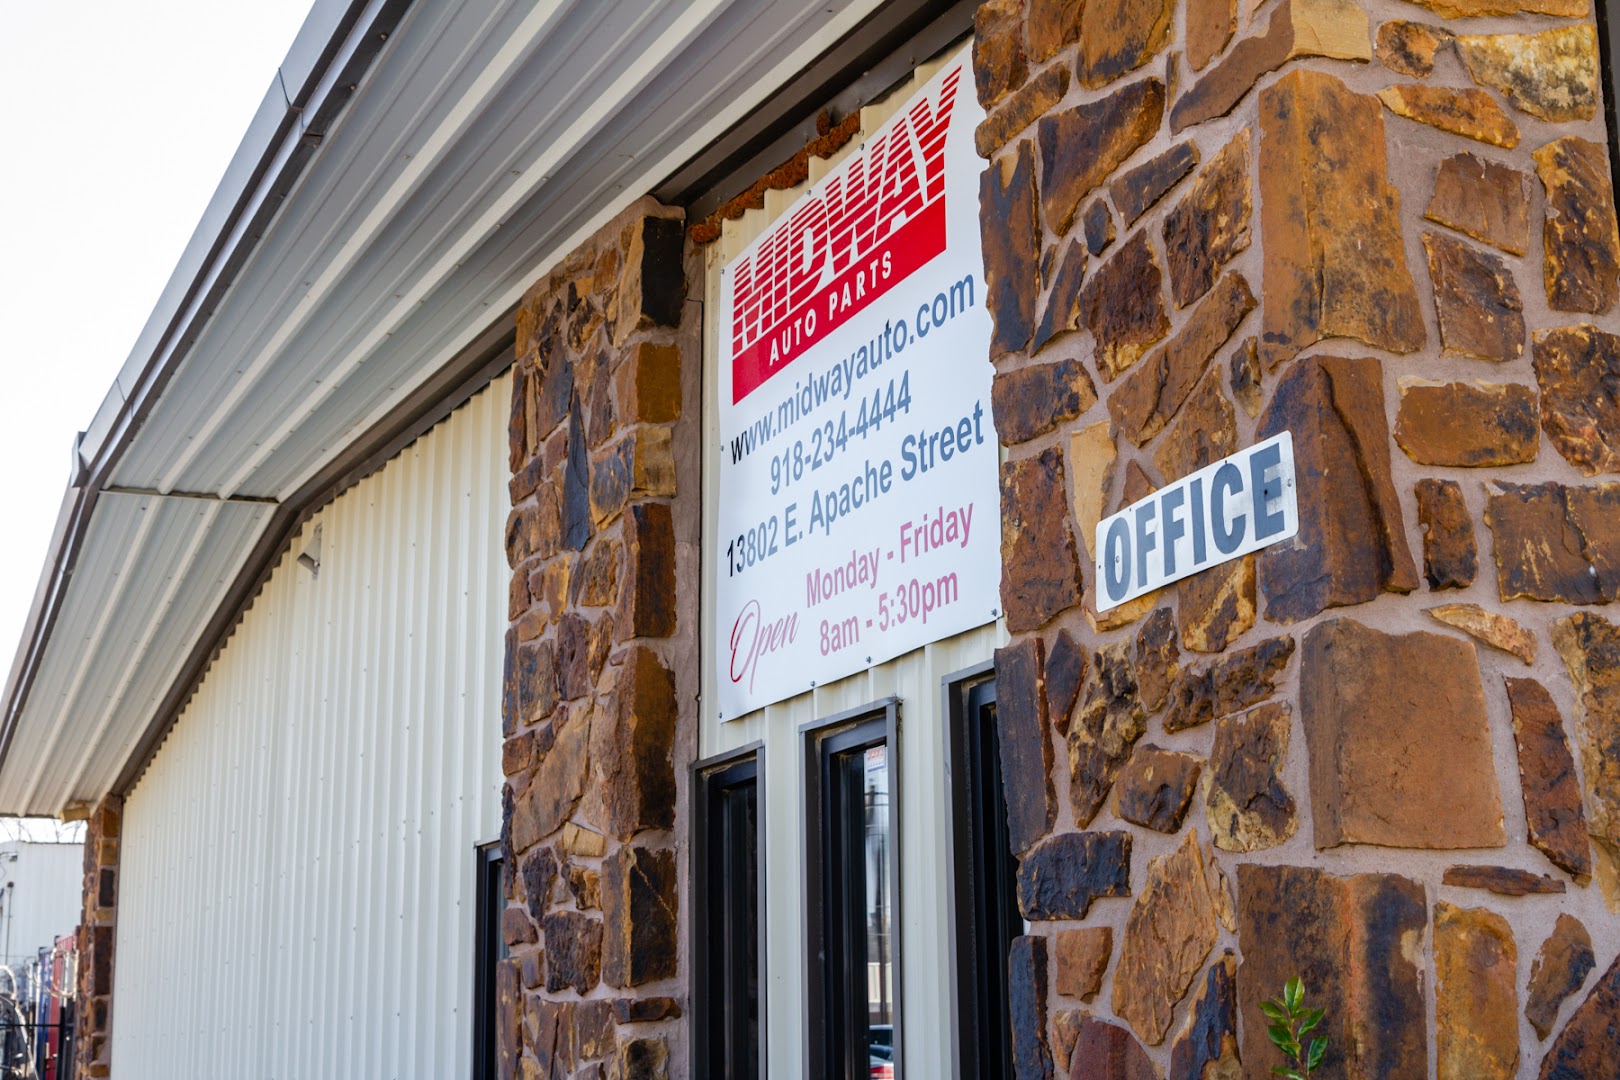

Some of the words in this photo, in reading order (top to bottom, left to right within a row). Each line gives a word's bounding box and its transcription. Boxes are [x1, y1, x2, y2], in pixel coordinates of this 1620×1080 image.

[732, 64, 963, 359] MIDWAY
[730, 273, 975, 465] www.midwayauto.com
[769, 308, 817, 367] AUTO
[829, 250, 892, 321] PARTS
[726, 515, 778, 578] 13802
[784, 502, 804, 548] E.
[808, 458, 893, 536] Apache
[900, 398, 985, 482] Street
[770, 369, 912, 496] 918-234-4444
[806, 547, 880, 609] Monday
[899, 502, 974, 564] Friday
[1104, 441, 1286, 602] OFFICE
[729, 599, 800, 695] Open
[819, 614, 860, 657] 8am
[878, 571, 958, 633] 5:30pm
